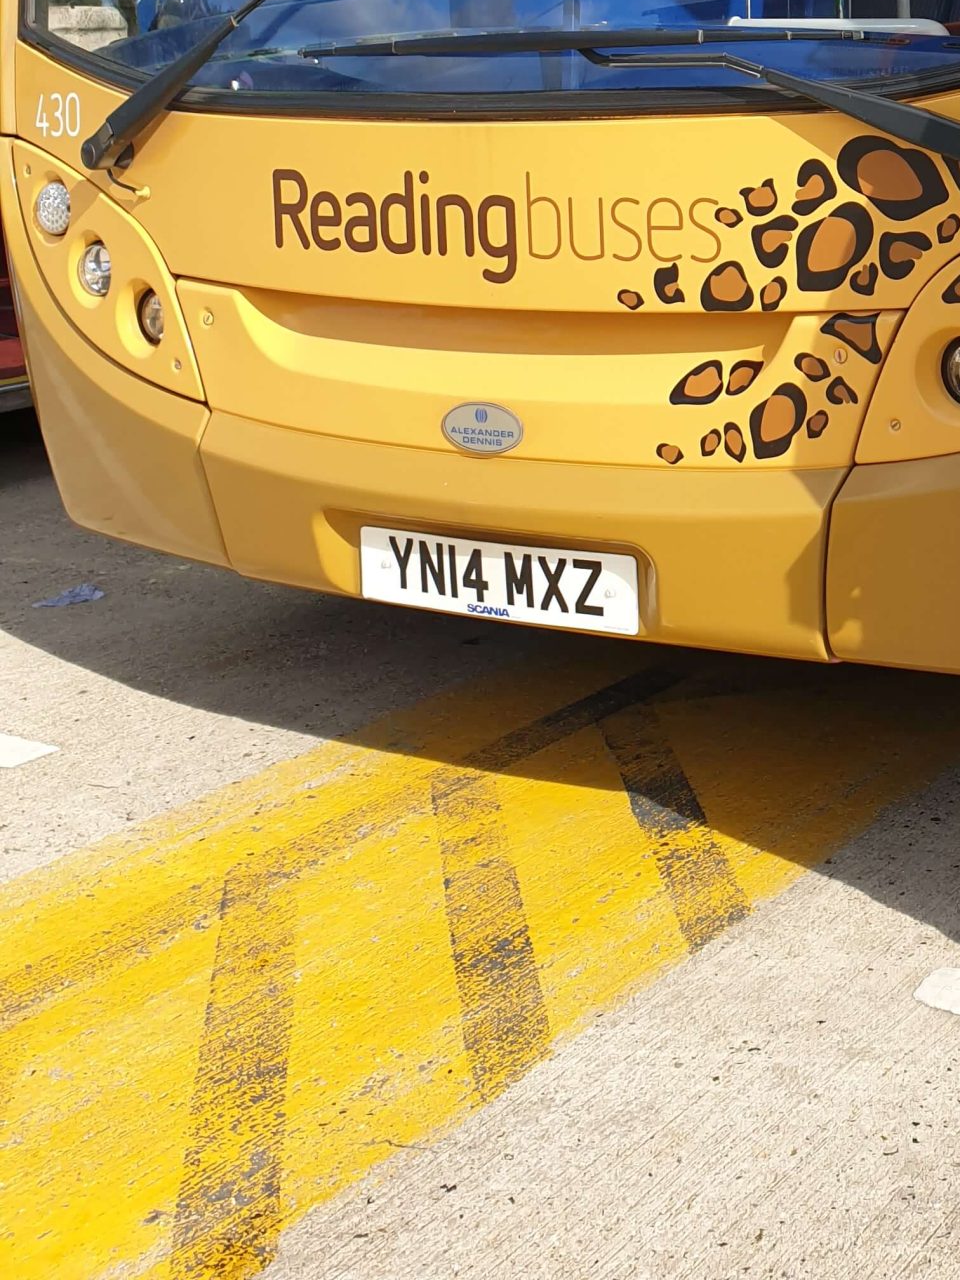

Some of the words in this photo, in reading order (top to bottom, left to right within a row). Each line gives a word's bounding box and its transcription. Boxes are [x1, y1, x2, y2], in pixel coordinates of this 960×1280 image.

[36, 92, 80, 137] 430
[450, 425, 515, 439] ALEXANDER
[462, 436, 503, 447] DENNIS
[388, 535, 489, 603] YN14
[503, 551, 605, 617] MXZ
[467, 603, 510, 618] SCANIA
